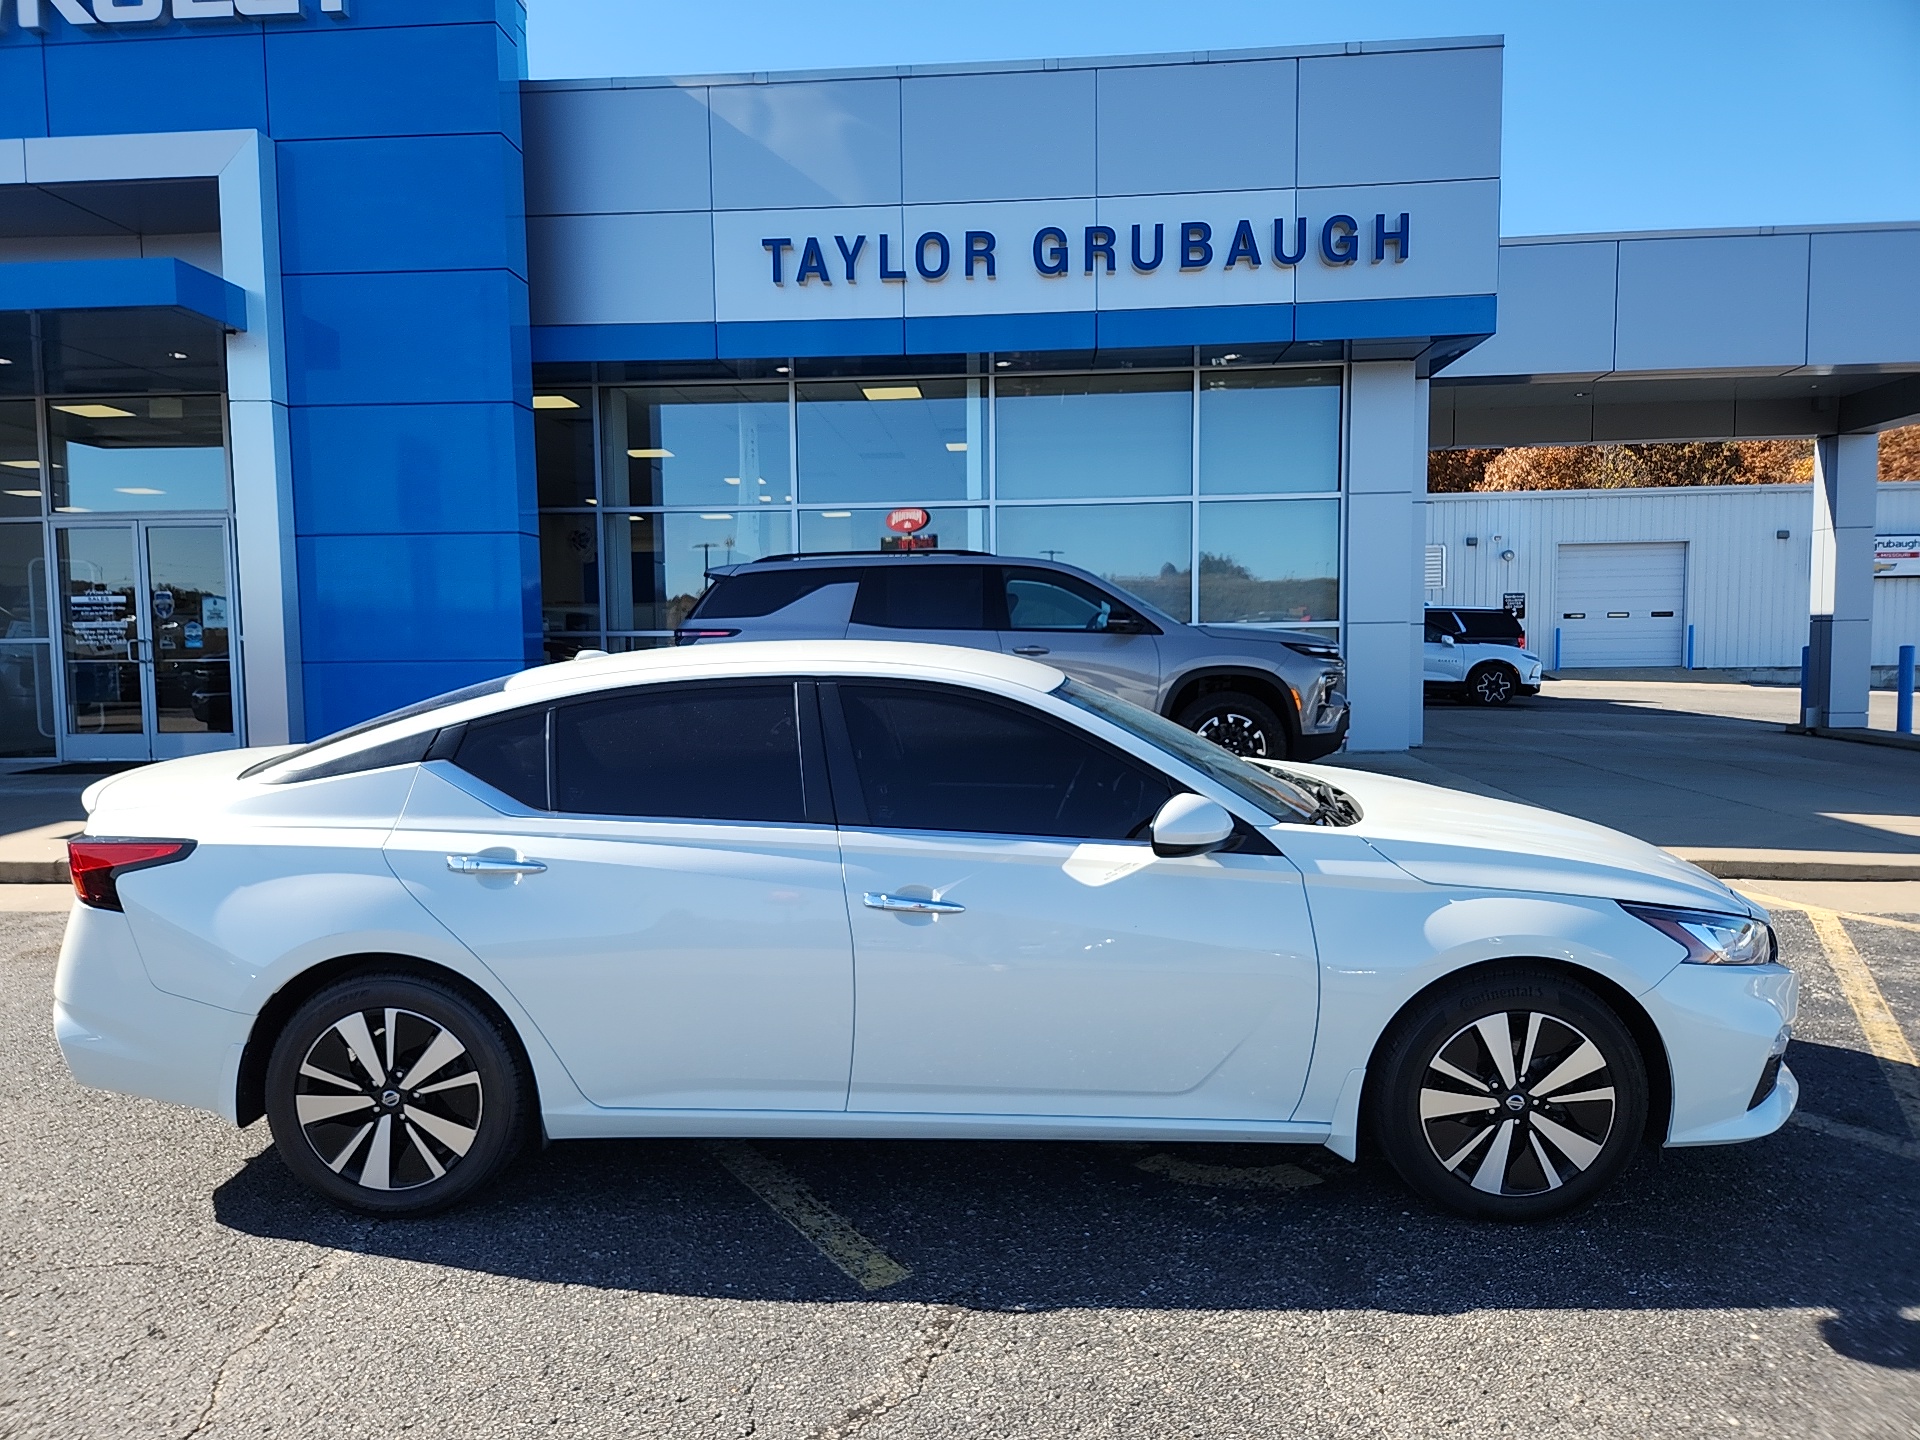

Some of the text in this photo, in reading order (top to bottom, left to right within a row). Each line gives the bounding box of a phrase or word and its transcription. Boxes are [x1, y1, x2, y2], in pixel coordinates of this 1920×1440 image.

[761, 212, 1411, 286] TAYLOR GRUBAUGH
[1460, 985, 1532, 1010] Continental
